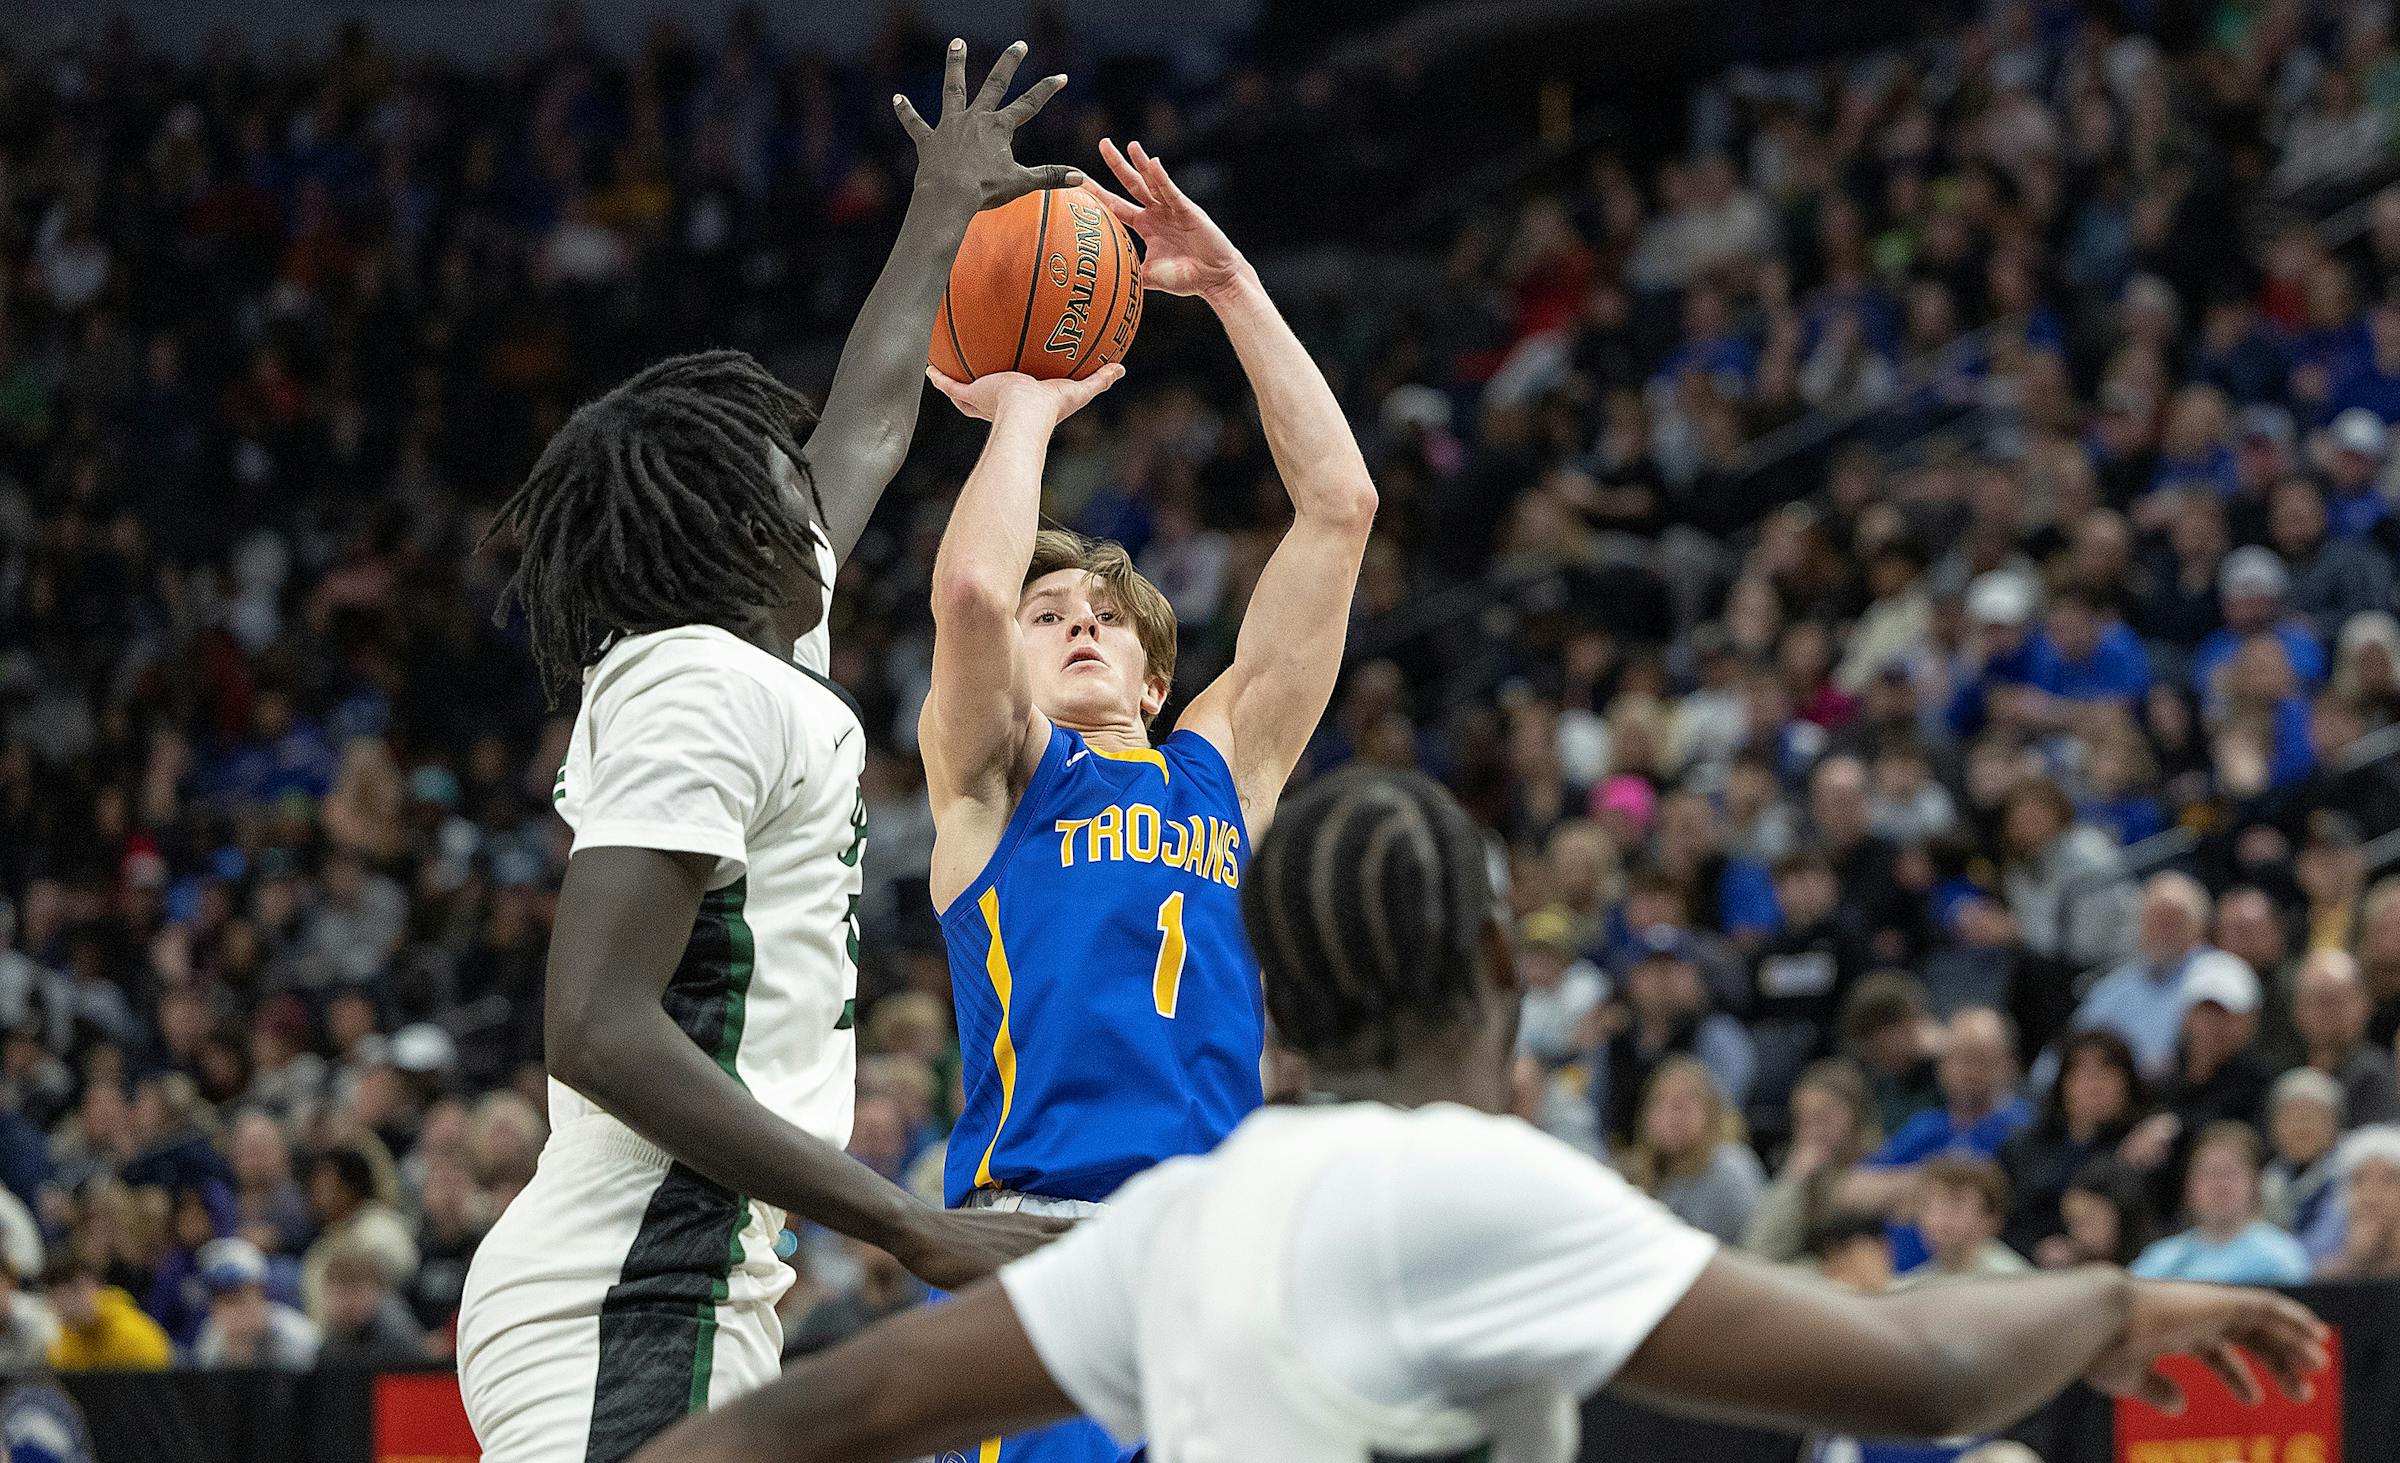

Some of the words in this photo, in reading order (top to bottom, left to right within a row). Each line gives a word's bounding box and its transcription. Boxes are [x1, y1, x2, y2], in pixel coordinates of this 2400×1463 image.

[1045, 203, 1102, 360] SPALDING
[1055, 803, 1240, 889] TROJANS
[1153, 891, 1187, 1019] 1
